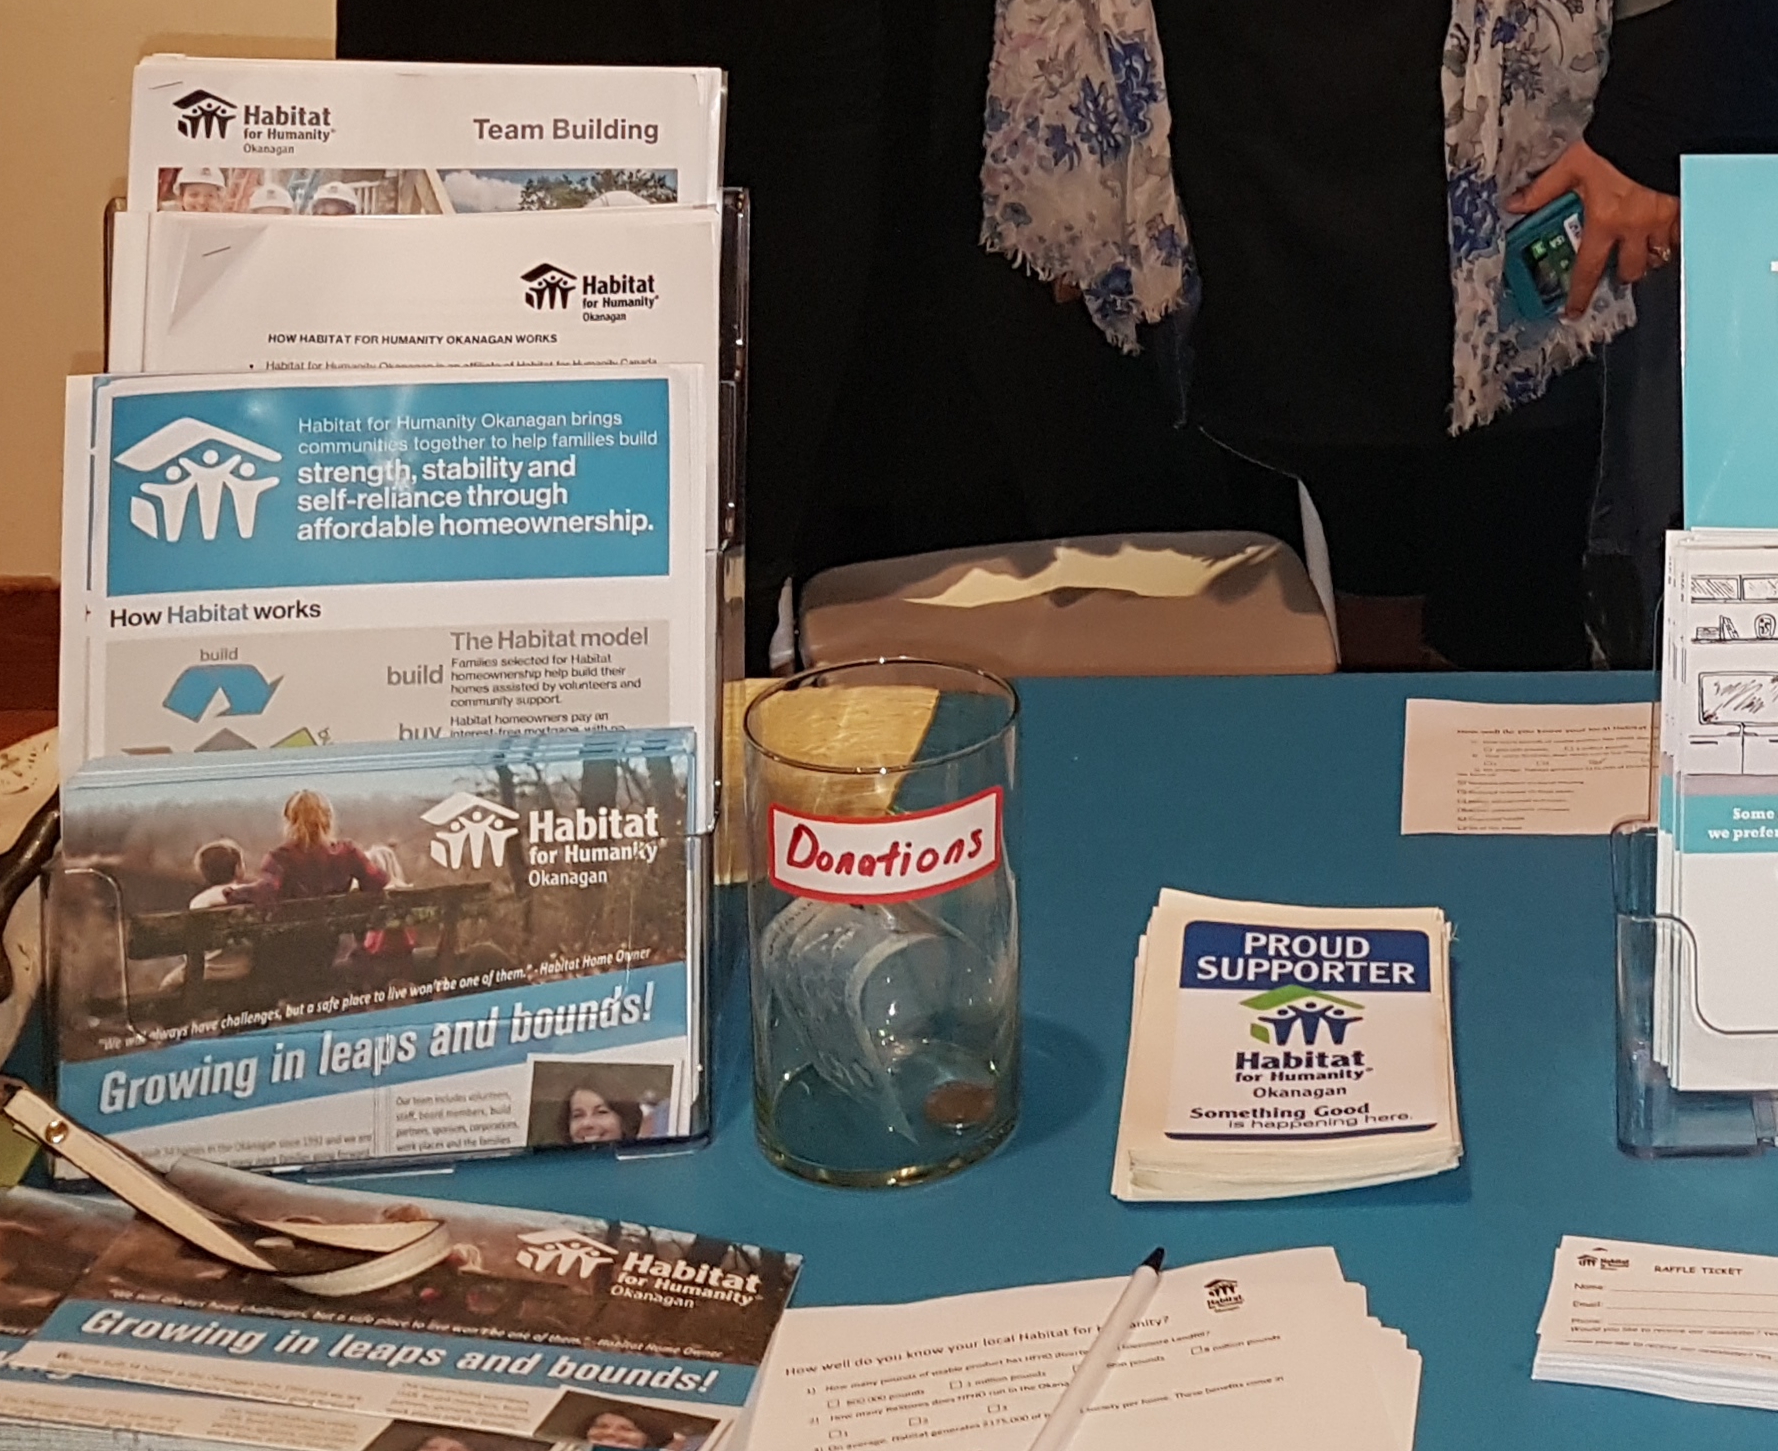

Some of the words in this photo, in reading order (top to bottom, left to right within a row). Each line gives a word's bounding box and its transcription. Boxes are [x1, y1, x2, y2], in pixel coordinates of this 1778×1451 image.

[243, 104, 331, 127] Habitat
[243, 128, 264, 141] for
[473, 118, 545, 141] Team
[552, 118, 659, 145] Building
[243, 143, 295, 155] Okanagan
[582, 275, 655, 295] Habitat
[582, 297, 598, 309] for
[582, 312, 627, 322] Okanagan
[268, 334, 297, 344] HOW
[299, 334, 352, 344] HABITAT
[354, 335, 379, 344] FOR
[381, 334, 443, 345] HUMANITY
[446, 334, 513, 344] OKANAGAN
[515, 334, 557, 344] WORKS
[298, 418, 360, 433] Habitat
[365, 416, 391, 431] for
[397, 413, 475, 435] Humanity
[481, 411, 567, 432] Okanagan
[572, 410, 622, 430] brings
[298, 437, 408, 454] communities
[413, 434, 486, 452] together
[491, 434, 506, 449] to
[511, 433, 547, 452] help
[552, 431, 615, 447] families
[619, 430, 658, 446] build
[298, 459, 417, 487] strength,
[422, 457, 522, 484] stability
[528, 454, 576, 477] and
[298, 488, 462, 512] self-reliance
[467, 485, 568, 511] through
[297, 515, 434, 542] affordable
[439, 511, 654, 538] homeownership.
[110, 607, 162, 628] How
[167, 603, 249, 624] Habitat
[253, 601, 321, 621] works
[450, 632, 493, 650] The
[498, 630, 577, 649] Habitat
[581, 627, 649, 647] model
[387, 664, 444, 685] build
[529, 806, 659, 842] Habitat
[1733, 807, 1774, 820] Some
[1708, 828, 1729, 839] we
[530, 845, 557, 865] for
[786, 823, 983, 877] Donations
[529, 869, 608, 888] Okanagan
[1244, 932, 1370, 960] PROUD
[1196, 956, 1415, 984] SUPPORTER
[98, 1055, 259, 1115] Growing
[272, 1042, 304, 1080] in
[319, 1024, 417, 1078] leaps
[430, 1008, 500, 1057] and
[510, 980, 657, 1044] bounds!
[1235, 1050, 1365, 1070] Habitat
[1235, 1071, 1264, 1083] for
[1253, 1086, 1347, 1099] Okanagan
[1190, 1106, 1306, 1120] Something
[1314, 1103, 1370, 1117] Good
[1229, 1120, 1245, 1129] is
[1251, 1117, 1358, 1130] happening
[1365, 1113, 1413, 1122] here.
[615, 1272, 648, 1287] for
[622, 1251, 763, 1294] Habitat
[1654, 1265, 1695, 1275] RAFFLE
[1701, 1266, 1743, 1276] TICKET
[610, 1285, 695, 1309] Okanagan
[80, 1308, 268, 1355] Growing
[274, 1329, 320, 1354] in
[328, 1333, 447, 1368] leaps
[457, 1348, 540, 1376] and
[547, 1356, 719, 1393] bounds!
